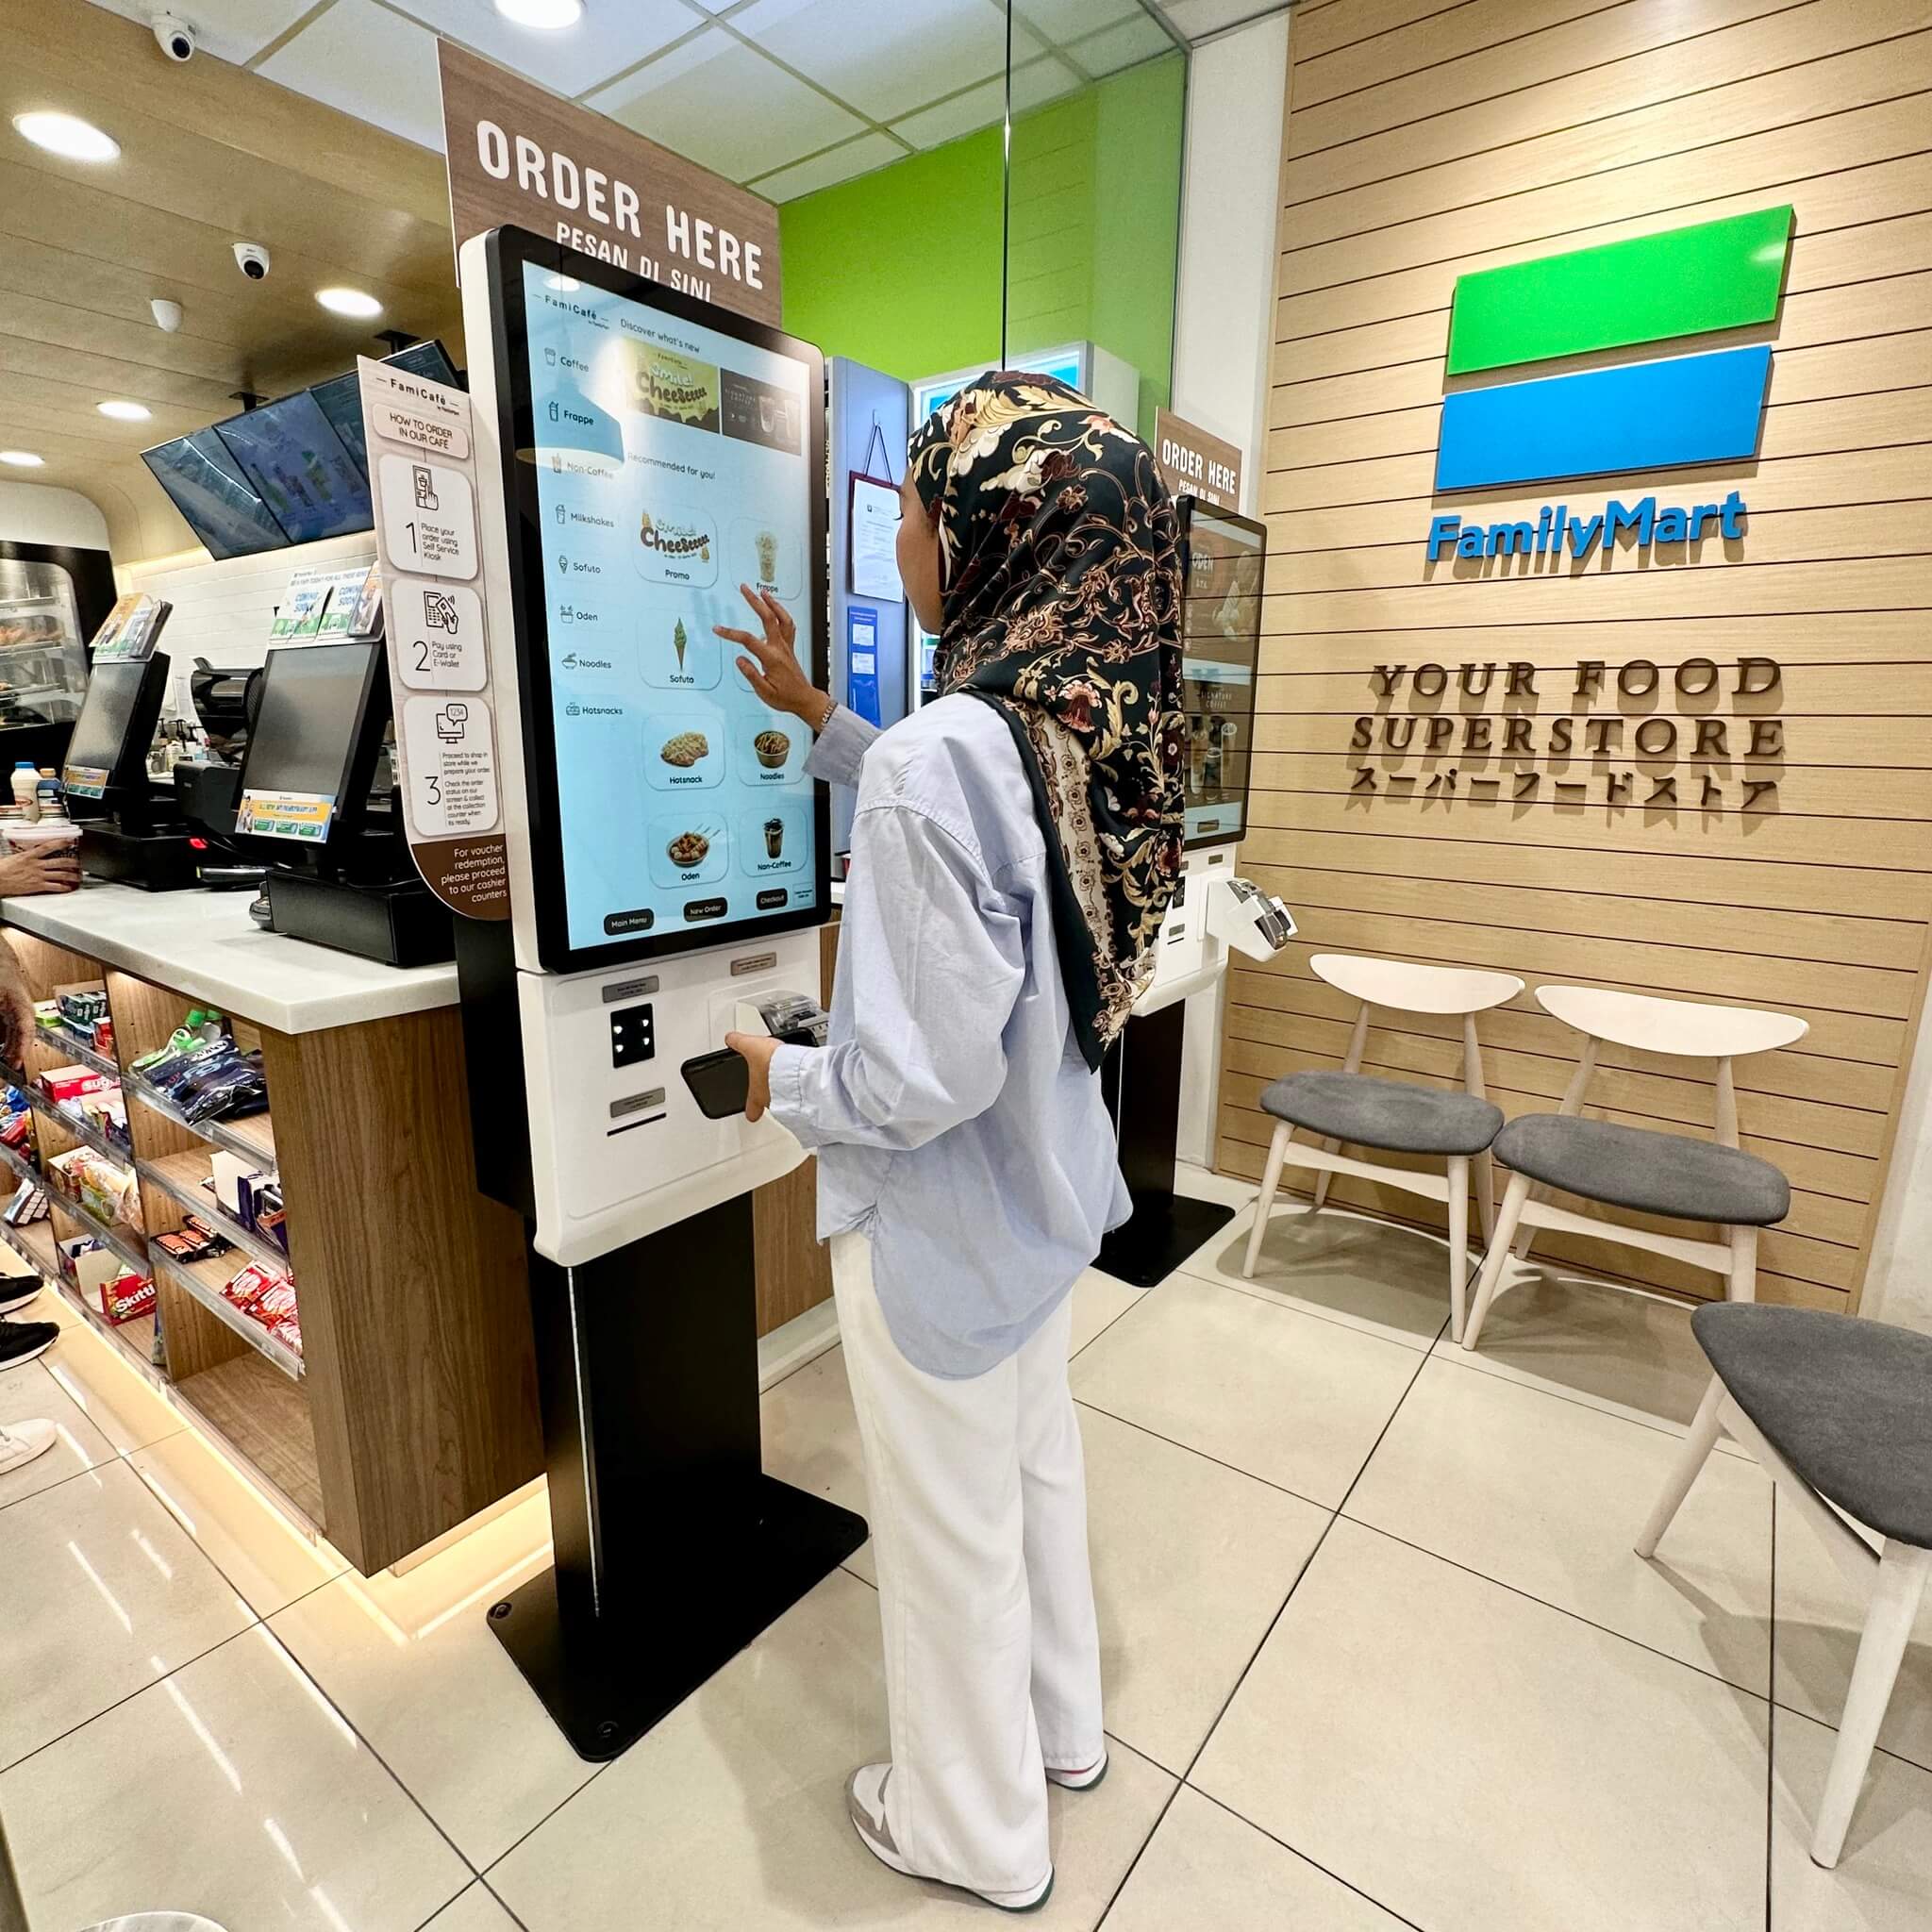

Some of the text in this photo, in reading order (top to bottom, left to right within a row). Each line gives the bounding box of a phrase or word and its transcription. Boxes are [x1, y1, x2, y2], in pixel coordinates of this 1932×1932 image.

[476, 120, 763, 290] ORDER HERE
[557, 222, 711, 302] PESAN DI SINI
[620, 318, 656, 340] Discover
[658, 332, 683, 348] what's
[684, 342, 701, 354] new
[559, 356, 590, 373] Coffee
[390, 412, 453, 439] HOW TO ORDER
[563, 410, 594, 426] Frappe
[399, 427, 449, 450] IN OUR CAFÉ
[567, 461, 613, 479] Non-Coffee
[627, 453, 716, 481] Recommended for you!
[1162, 439, 1236, 494] ORDER HERE
[1178, 478, 1198, 497] PESAN
[571, 512, 614, 527] Milkshakes
[1426, 490, 1748, 561] FamilyMart
[421, 523, 456, 538] Place your
[406, 522, 417, 555] 1
[422, 534, 458, 547] order using
[423, 541, 459, 556] Self Service
[424, 552, 441, 561] Kiosk
[1191, 552, 1214, 575] ODEN
[573, 562, 601, 574] Sofuto
[665, 569, 690, 580] Promo
[576, 611, 598, 622] Oden
[432, 641, 462, 652] Pay using
[432, 650, 448, 658] Card
[412, 641, 431, 672] 2
[434, 658, 459, 668] E-Wallet
[579, 658, 611, 669] Noodles
[670, 675, 694, 684] Sofuto
[1373, 657, 1783, 697] YOUR FOOD
[582, 706, 623, 716] Hotsnacks
[1351, 717, 1784, 757] SUPERSTORE
[669, 775, 703, 785] Hotsnack
[759, 772, 785, 781] Noodles
[425, 776, 441, 806] 3
[1351, 766, 1779, 809] スーパーフードストア
[454, 844, 504, 858] For voucher
[758, 859, 791, 872] Non-Coffee
[441, 867, 506, 886] please proceed
[681, 872, 700, 881] Oden
[449, 878, 507, 894] to our cashier
[472, 890, 508, 903] counters
[760, 893, 785, 905] Checkout
[690, 903, 722, 915] New Order
[611, 916, 647, 928] Main Menu
